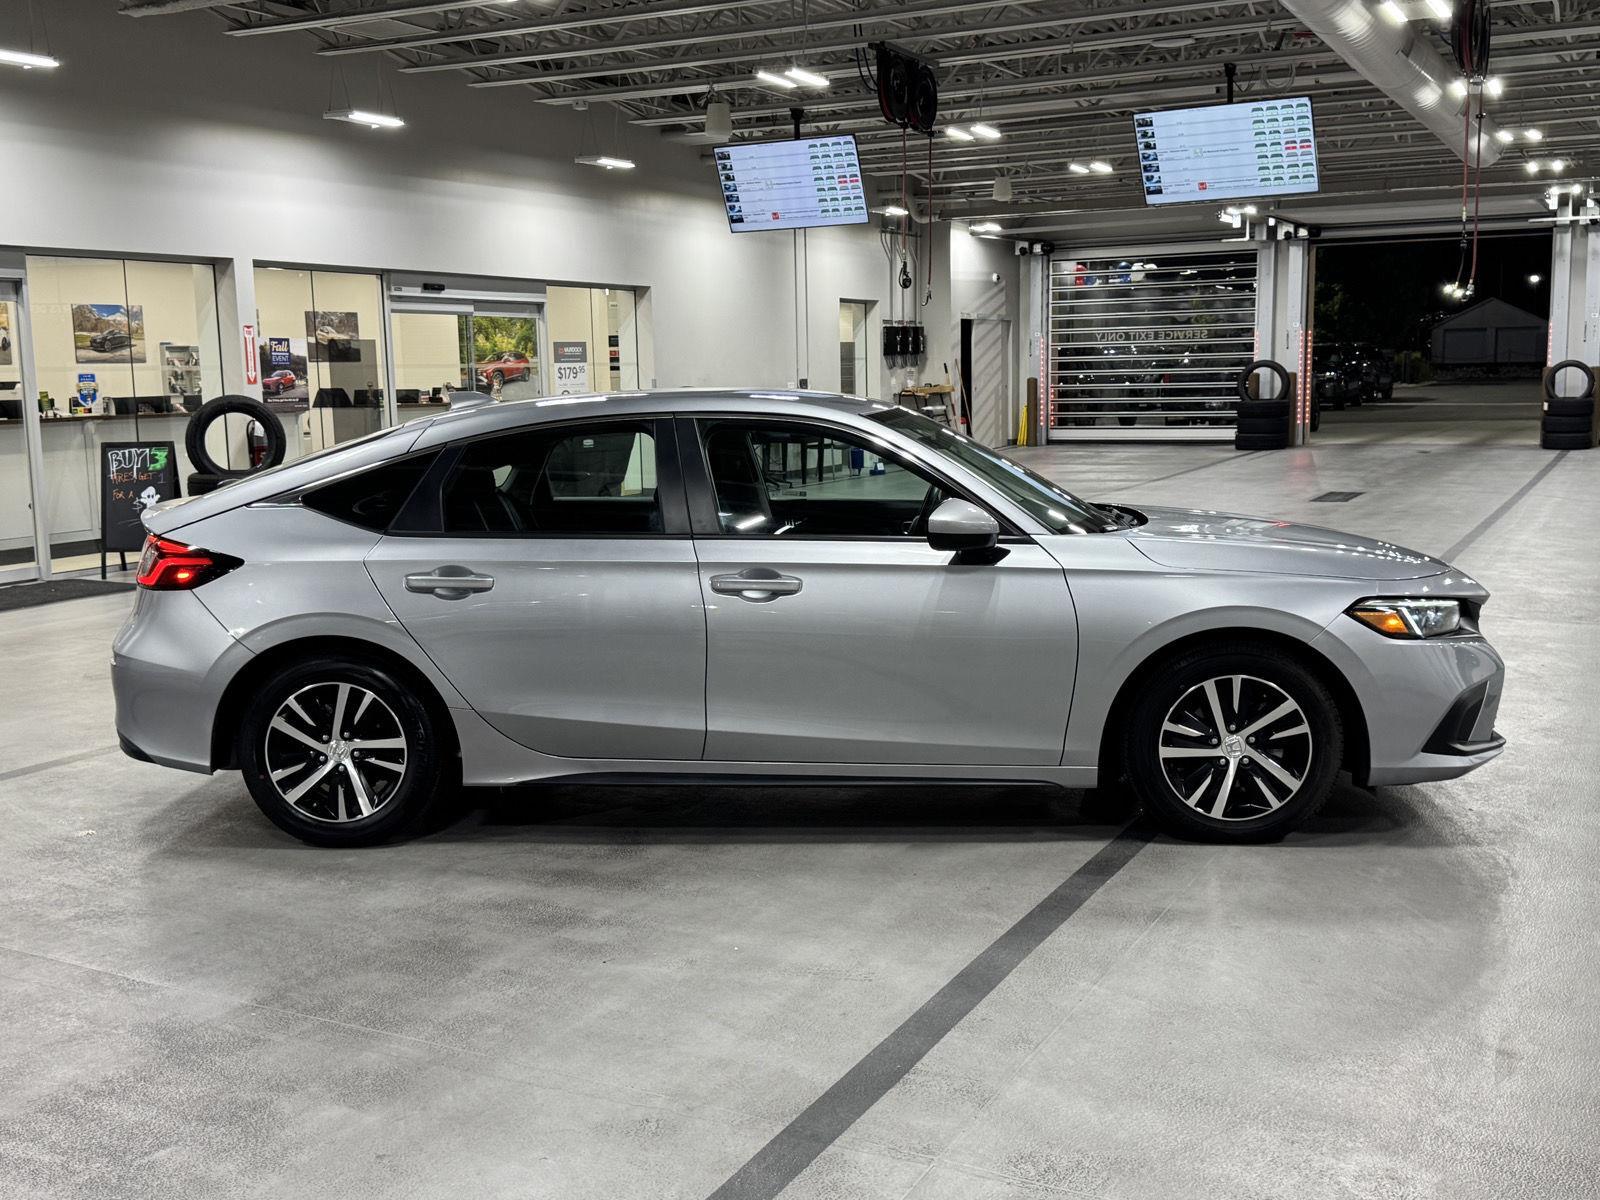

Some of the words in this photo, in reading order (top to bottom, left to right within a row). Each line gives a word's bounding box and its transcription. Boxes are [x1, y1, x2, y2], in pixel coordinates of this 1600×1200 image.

[271, 341, 289, 352] Fall
[108, 448, 150, 480] BUY
[148, 446, 169, 471] 3
